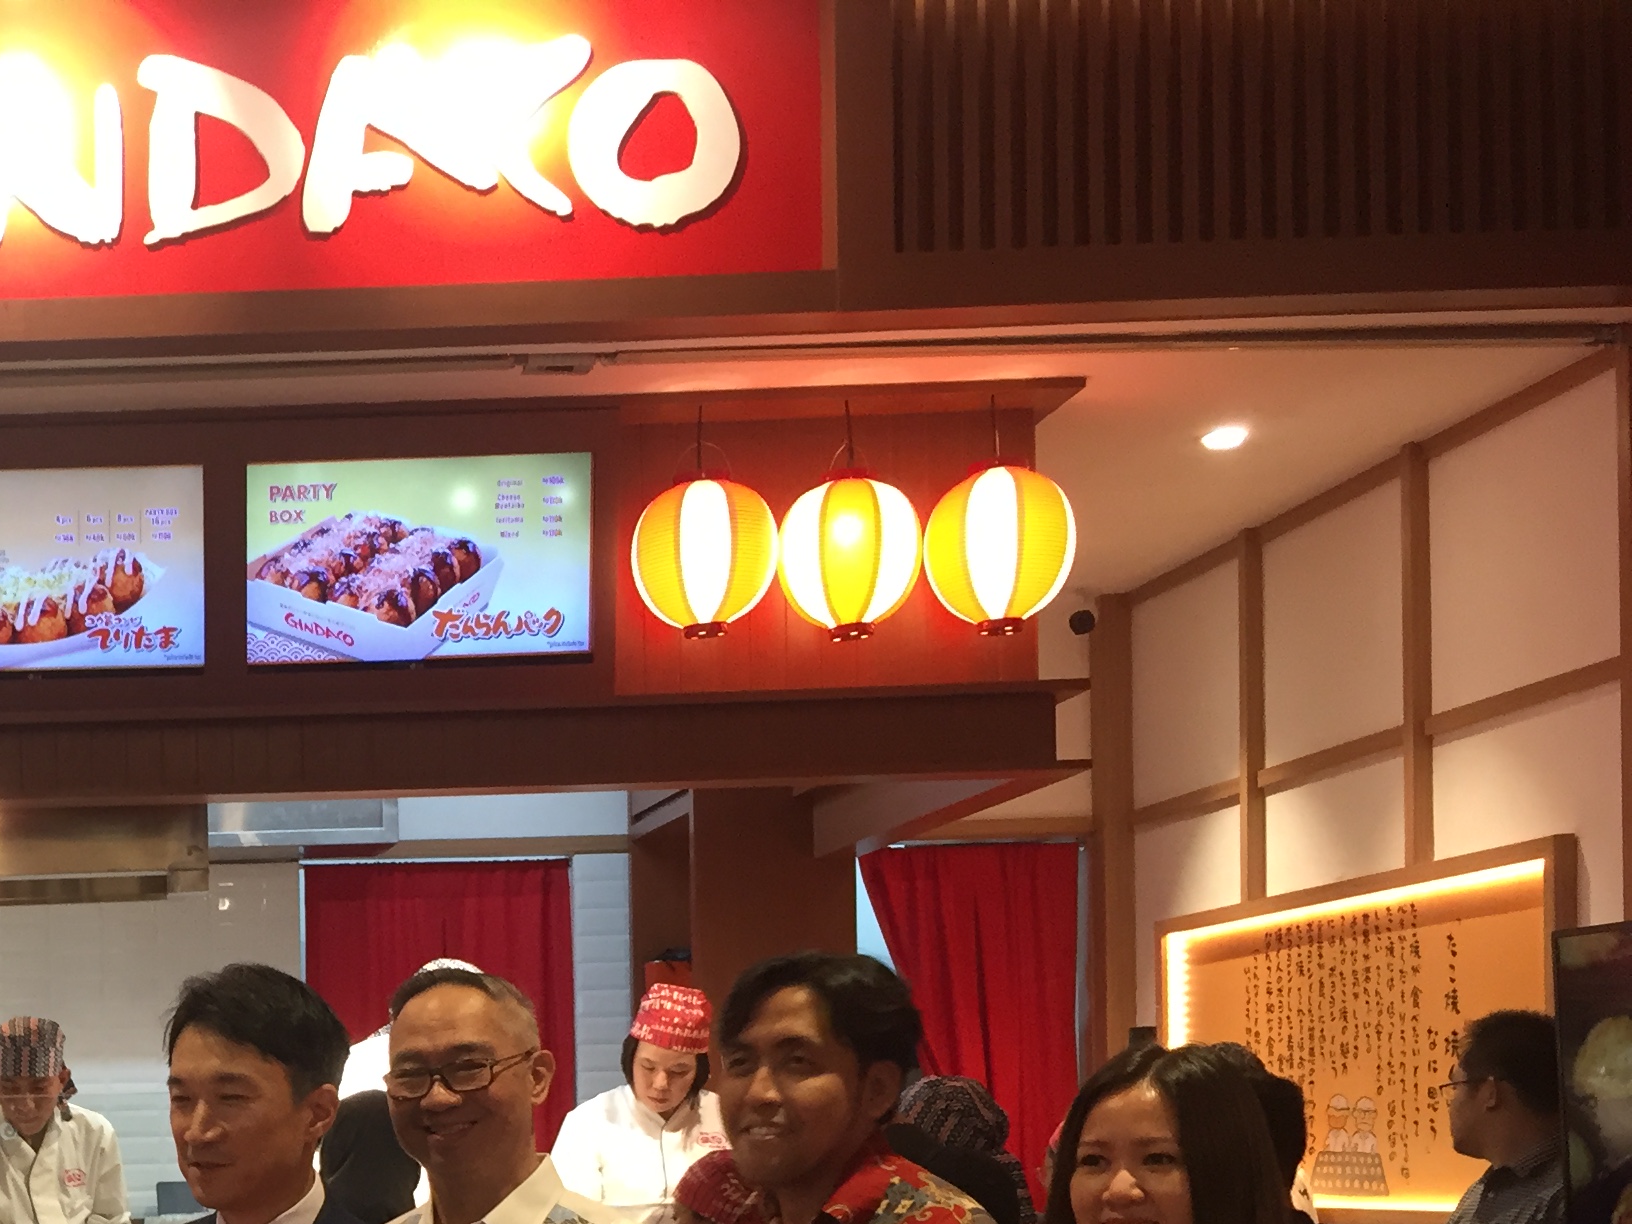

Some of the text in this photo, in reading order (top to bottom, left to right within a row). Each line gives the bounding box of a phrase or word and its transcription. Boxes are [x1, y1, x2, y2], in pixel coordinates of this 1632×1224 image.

[269, 483, 336, 502] PARTY
[269, 510, 305, 523] BOX
[284, 612, 355, 647] GINDACO
[431, 607, 563, 640] だんらんパック
[87, 624, 180, 651] てりたま
